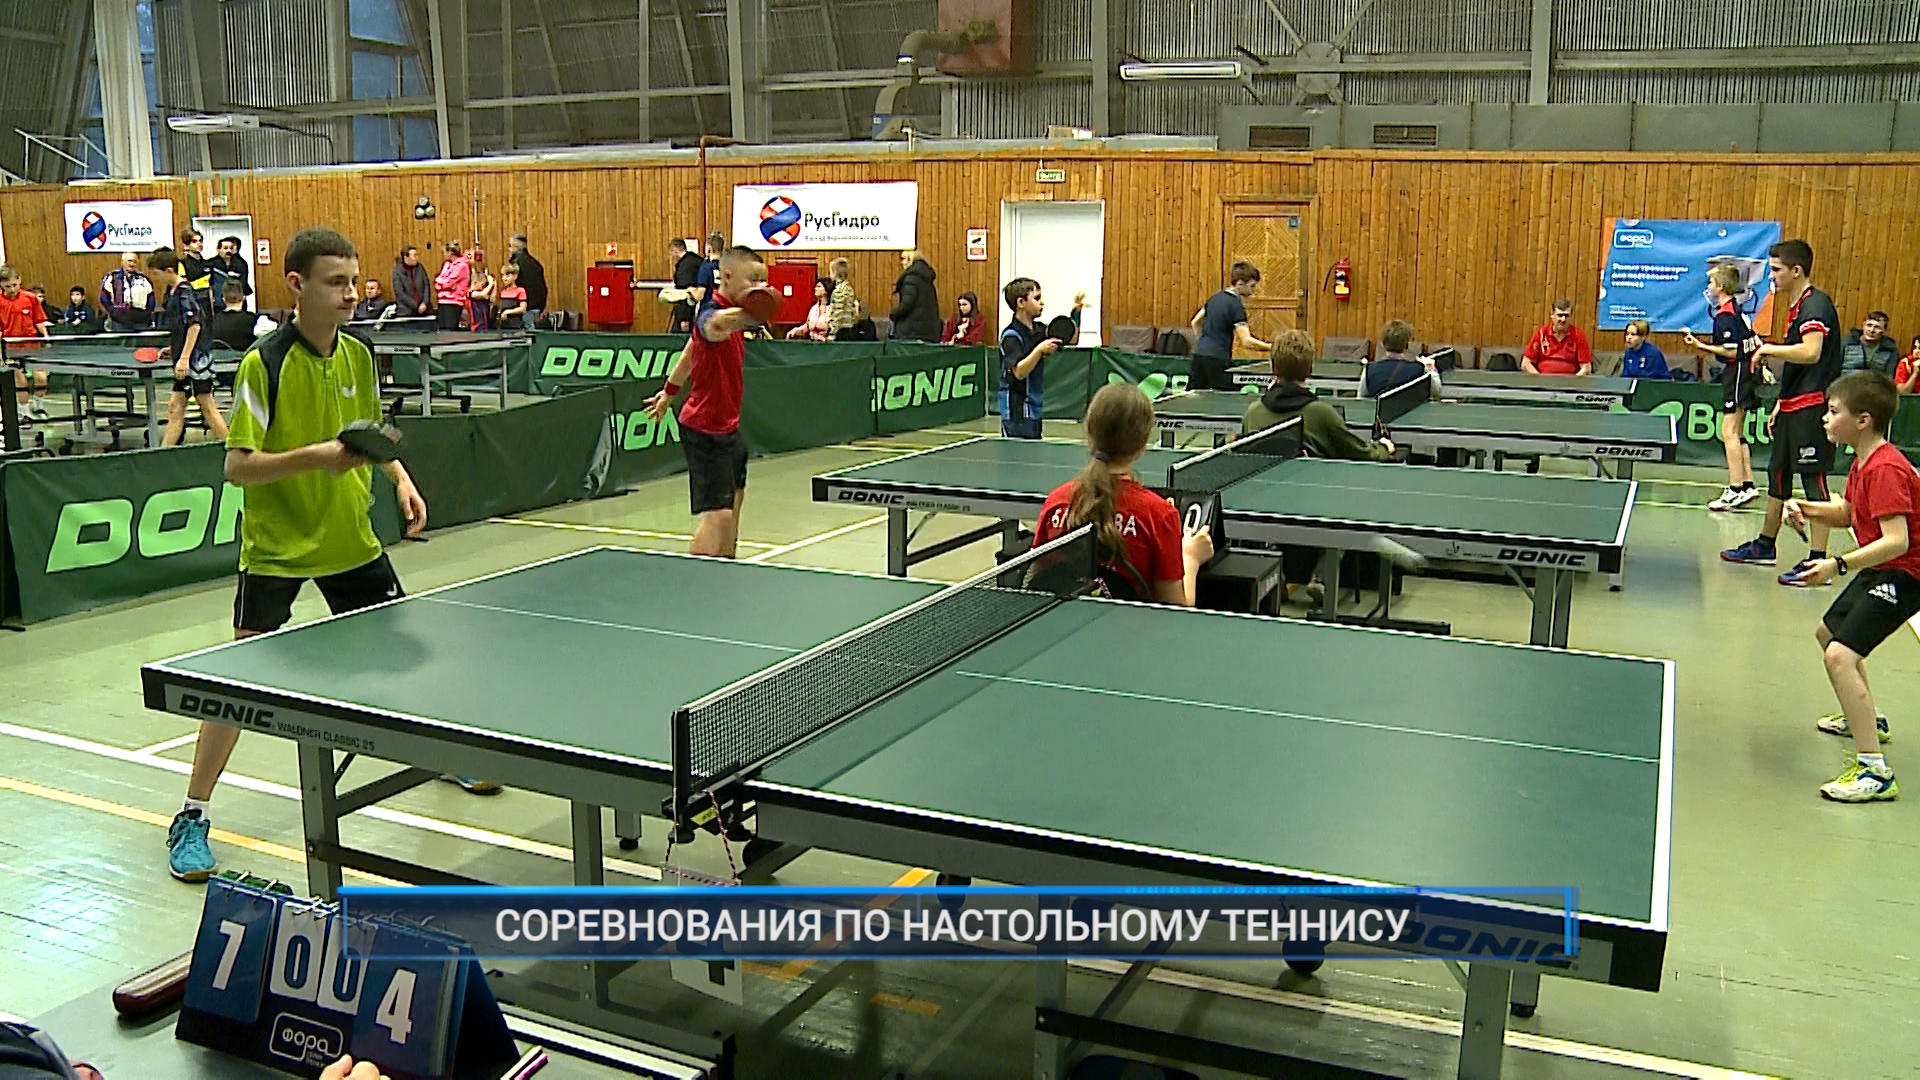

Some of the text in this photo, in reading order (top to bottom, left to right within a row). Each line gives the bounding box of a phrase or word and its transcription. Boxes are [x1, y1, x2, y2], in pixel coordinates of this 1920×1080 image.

[108, 223, 152, 238] РусГидро
[804, 211, 880, 231] РусГидро
[1155, 421, 1185, 429] NIC
[1594, 446, 1654, 458] DONIC
[838, 490, 905, 505] DONIC
[1496, 548, 1586, 567] DONIC
[180, 693, 275, 729] DONIC
[1383, 919, 1579, 970] DONIC
[212, 919, 418, 1045] 7 0 0 4
